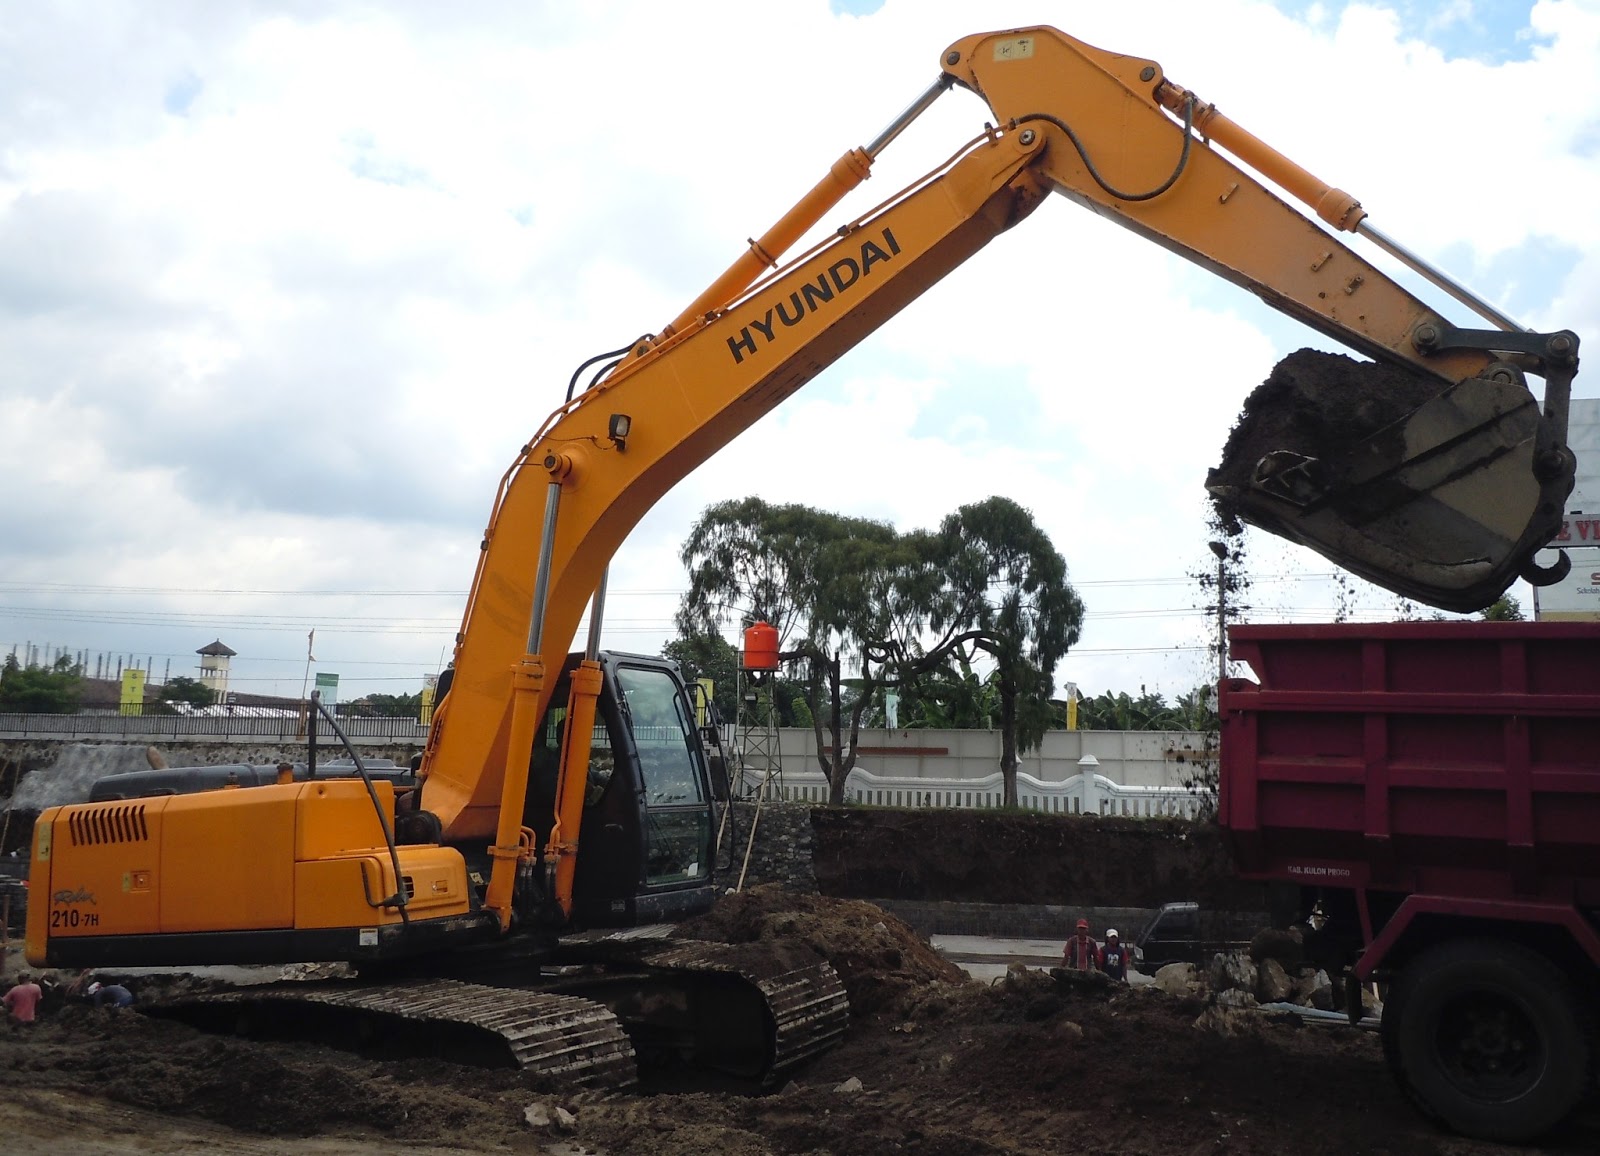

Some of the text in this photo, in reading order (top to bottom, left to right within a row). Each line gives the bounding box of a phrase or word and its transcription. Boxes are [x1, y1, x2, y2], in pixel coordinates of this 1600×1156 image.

[726, 227, 901, 365] HYUNDAI
[1304, 866, 1327, 875] KULON
[1328, 868, 1350, 877] PROGO
